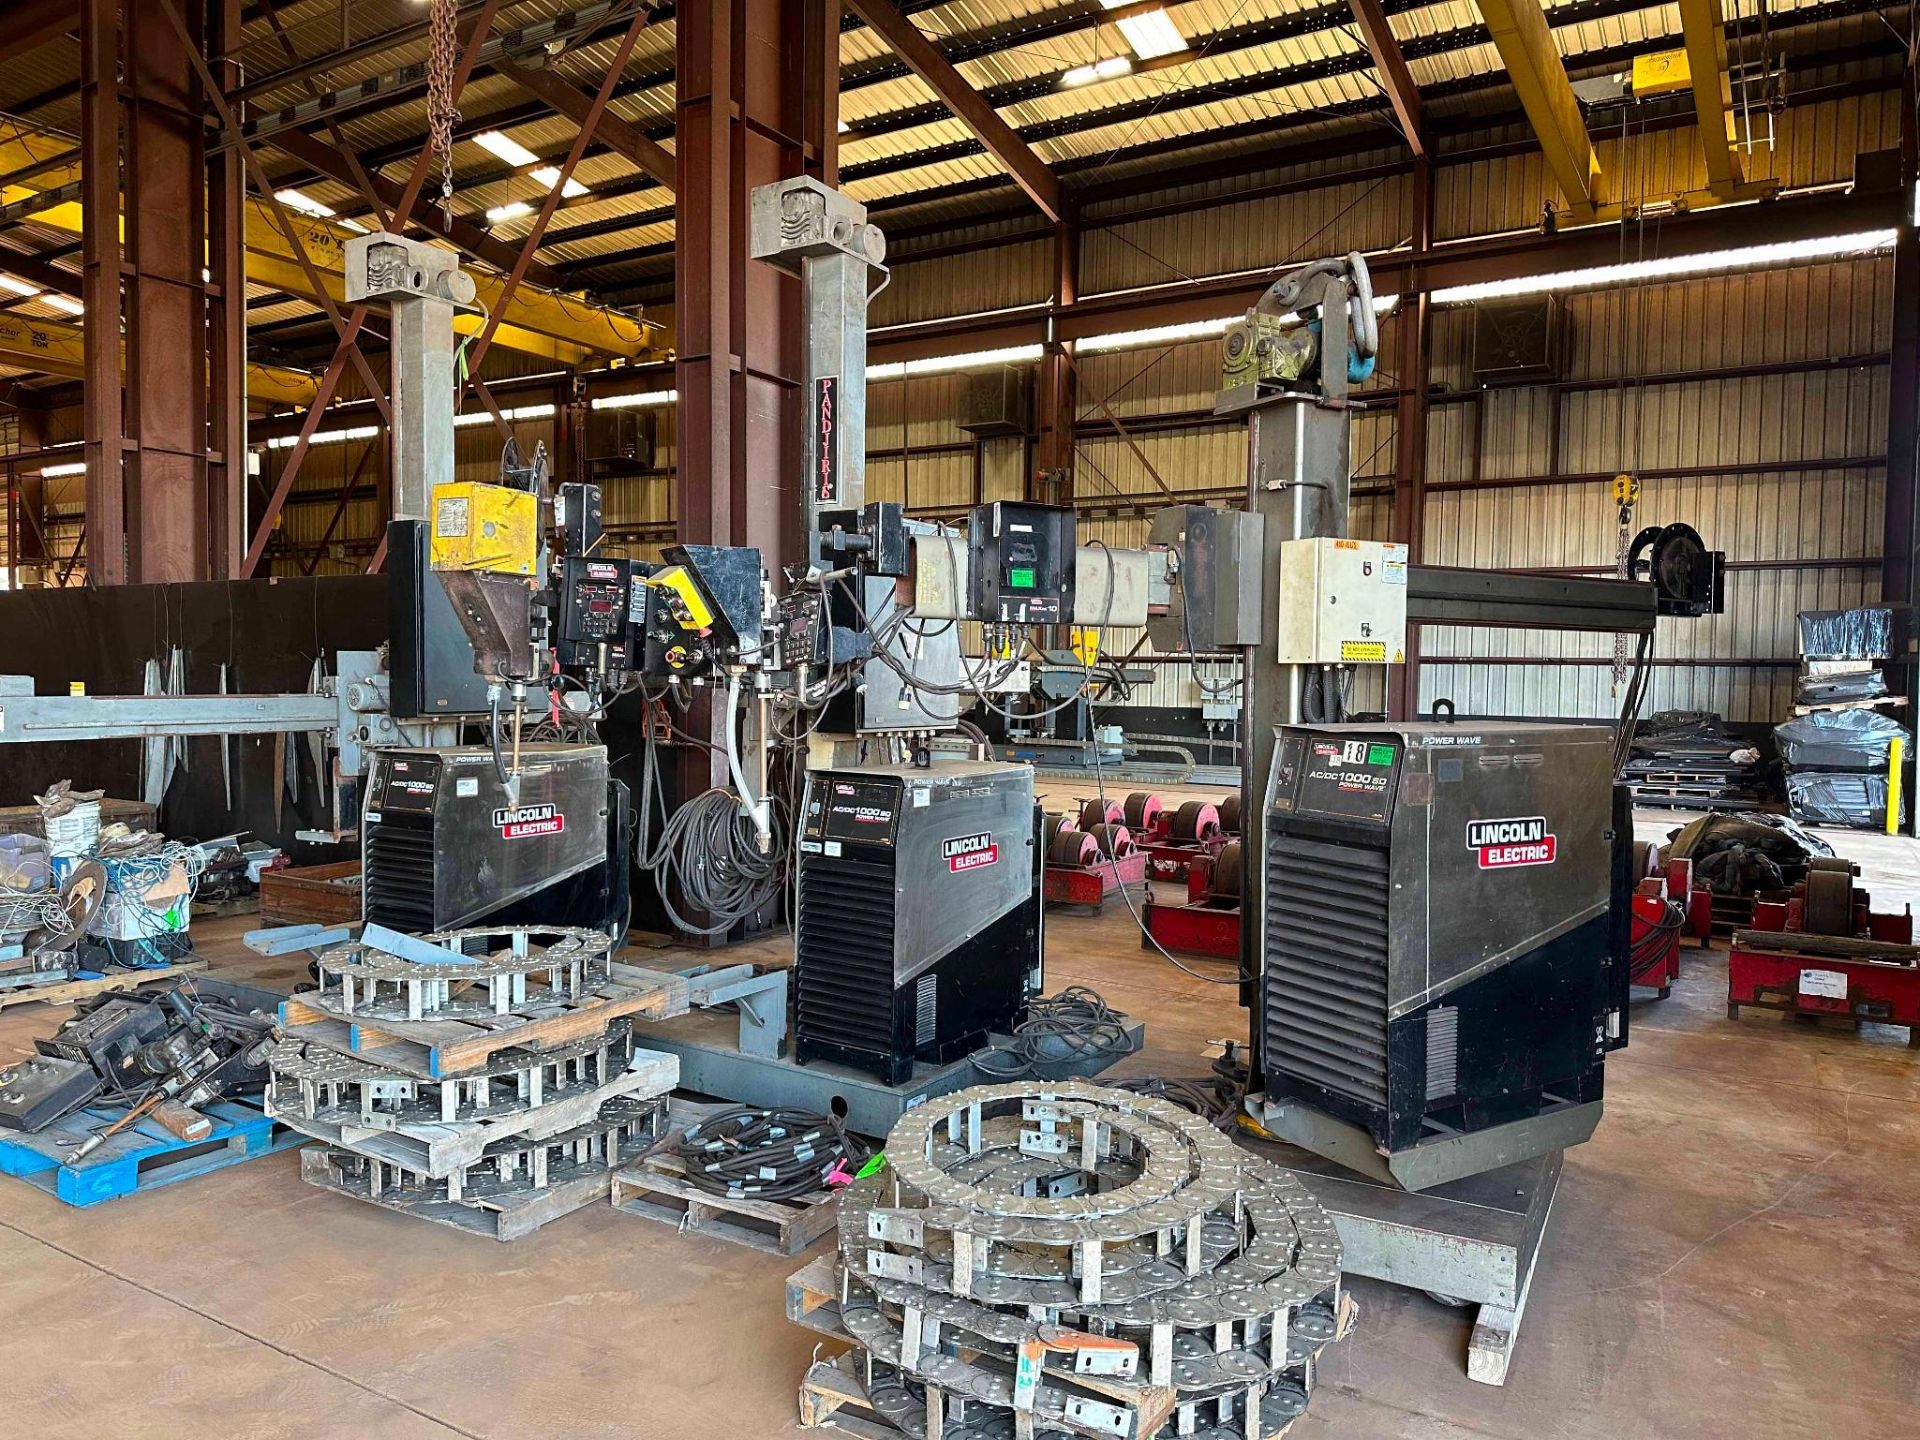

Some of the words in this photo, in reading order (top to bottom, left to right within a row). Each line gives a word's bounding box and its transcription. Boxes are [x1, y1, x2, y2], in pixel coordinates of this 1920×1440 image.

[32, 330, 47, 342] 20
[32, 339, 49, 349] TON
[1422, 736, 1454, 745] POWER
[1456, 736, 1482, 745] WAVE
[1347, 742, 1365, 763] 18
[1338, 781, 1363, 789] POWER
[1364, 783, 1385, 792] WAVE
[1372, 777, 1388, 786] SD
[496, 806, 552, 825] LINCOLN
[510, 821, 558, 836] ELECTRIC
[1471, 822, 1542, 845] LINCOLN
[944, 835, 989, 857] LINCOLN
[955, 851, 994, 869] ELECTRIC
[1487, 845, 1549, 864] ELECTRIC
